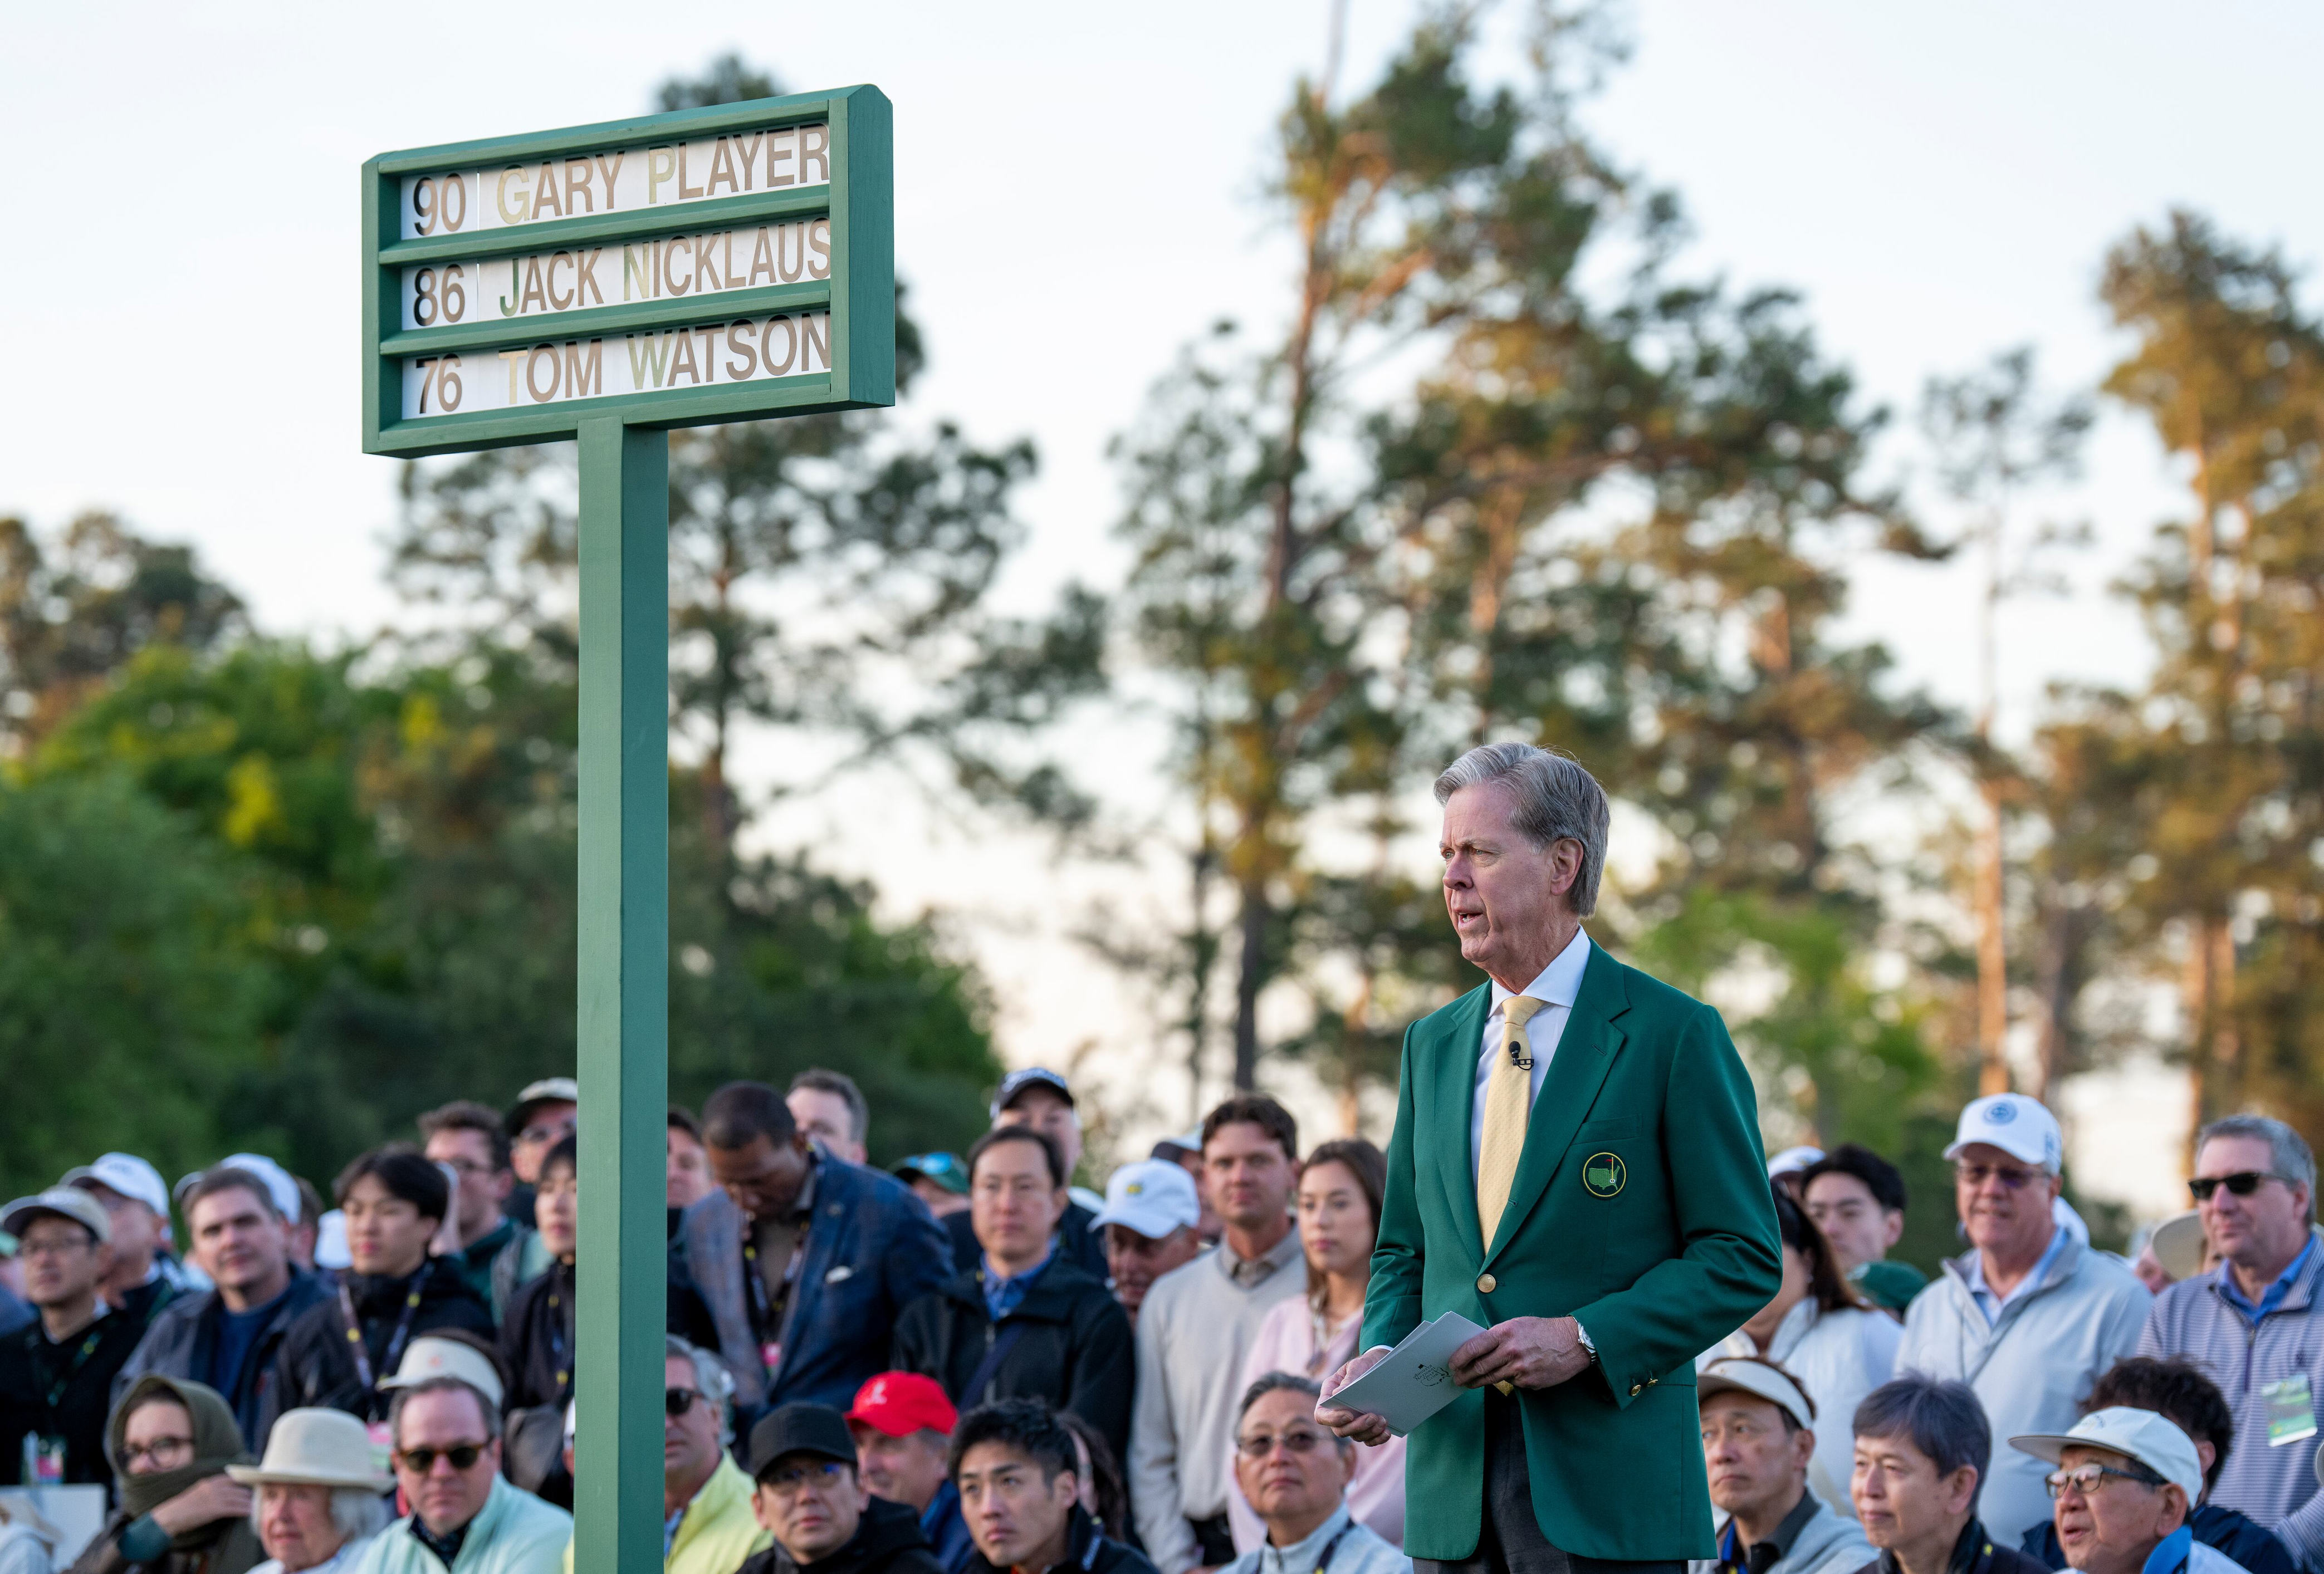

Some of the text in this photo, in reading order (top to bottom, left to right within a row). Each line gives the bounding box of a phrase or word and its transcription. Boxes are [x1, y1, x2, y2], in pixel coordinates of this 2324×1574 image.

[413, 123, 830, 236] 90 GARY PLAYER
[414, 218, 830, 326] 86 JACK NICKLAUS
[416, 311, 830, 414] 76 TOM WATSON
